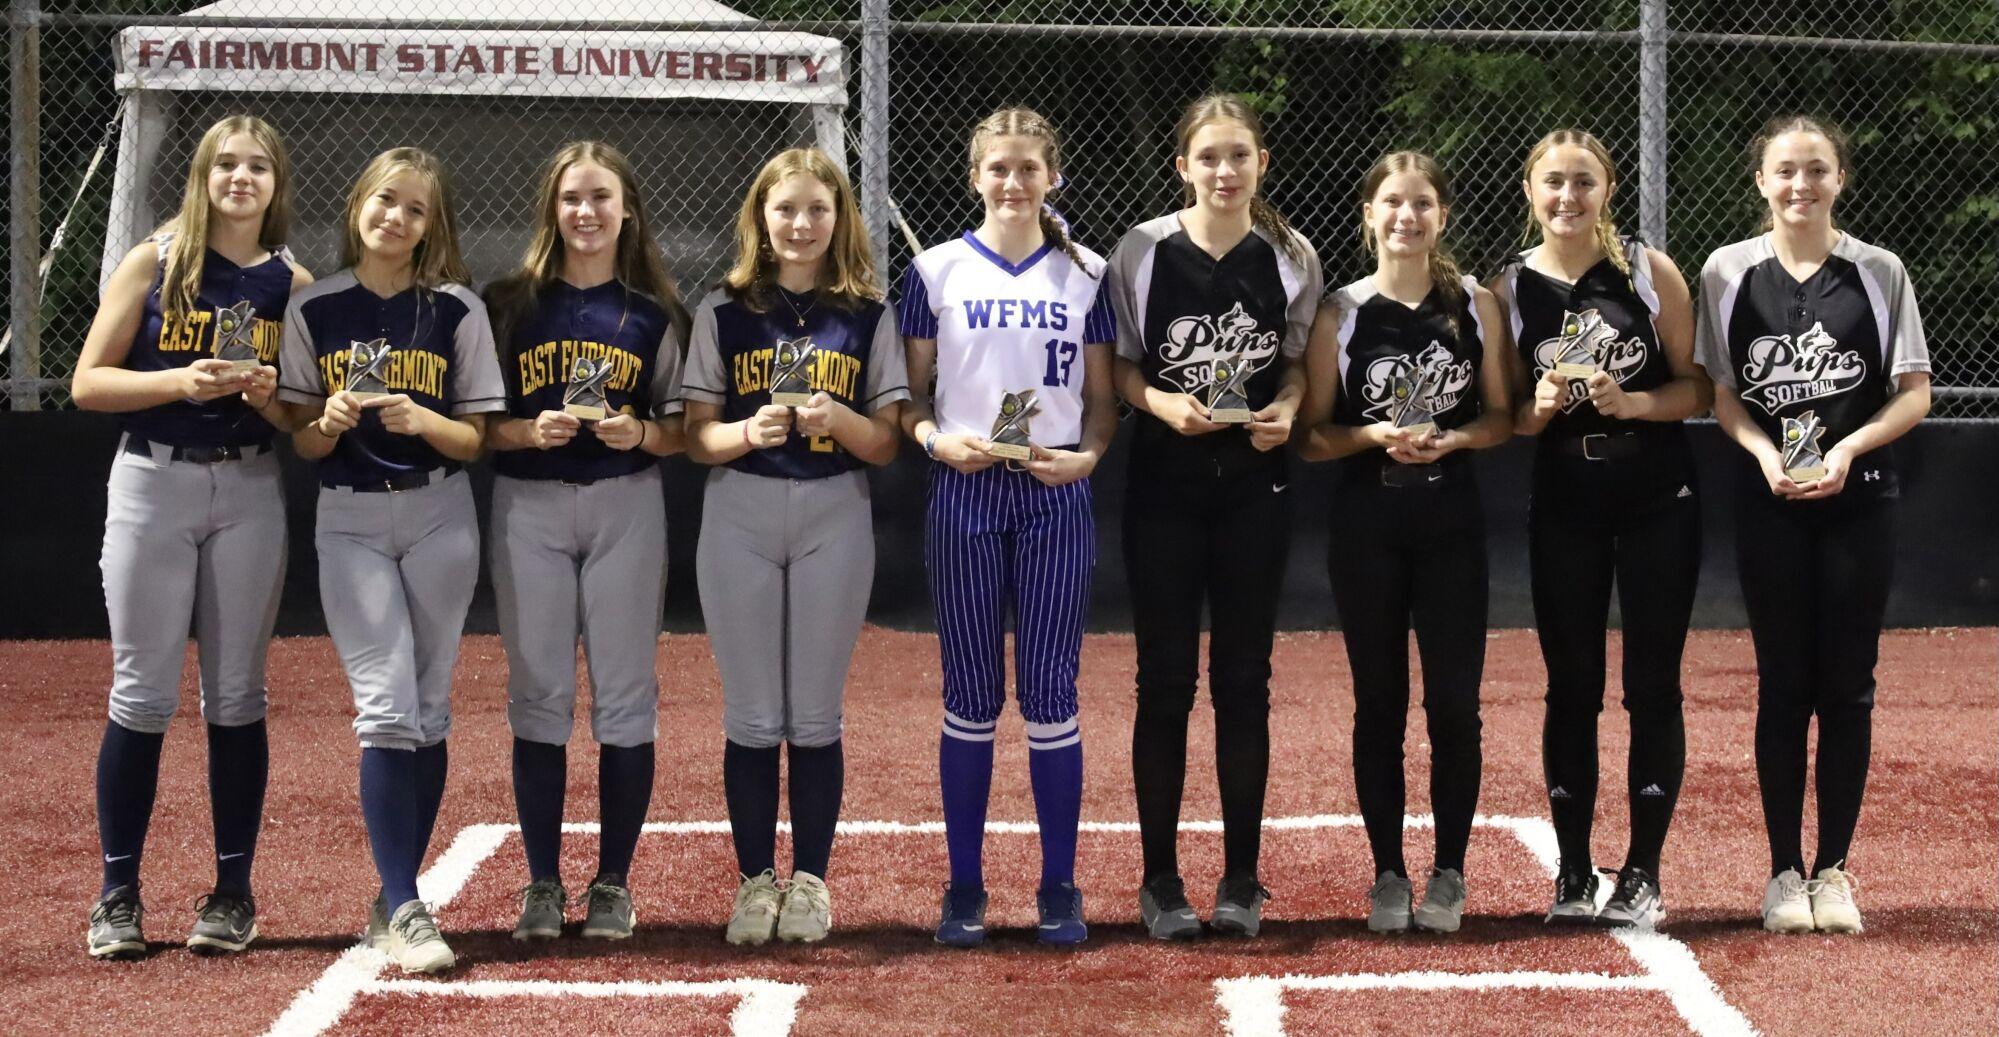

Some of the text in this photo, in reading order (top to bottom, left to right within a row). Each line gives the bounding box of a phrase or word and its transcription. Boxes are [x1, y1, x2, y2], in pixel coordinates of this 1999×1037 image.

[138, 39, 829, 83] FAIRMONT STATE UNIVERSITY
[158, 310, 212, 353] EAST
[963, 299, 1068, 331] WFMS
[1159, 315, 1279, 362] Pups
[382, 349, 448, 400] RMONT
[519, 341, 557, 397] EAST
[734, 348, 774, 396] EAST
[1043, 339, 1077, 388] 13
[1743, 335, 1864, 383] Pups
[1763, 380, 1837, 408] SOFTBALL
